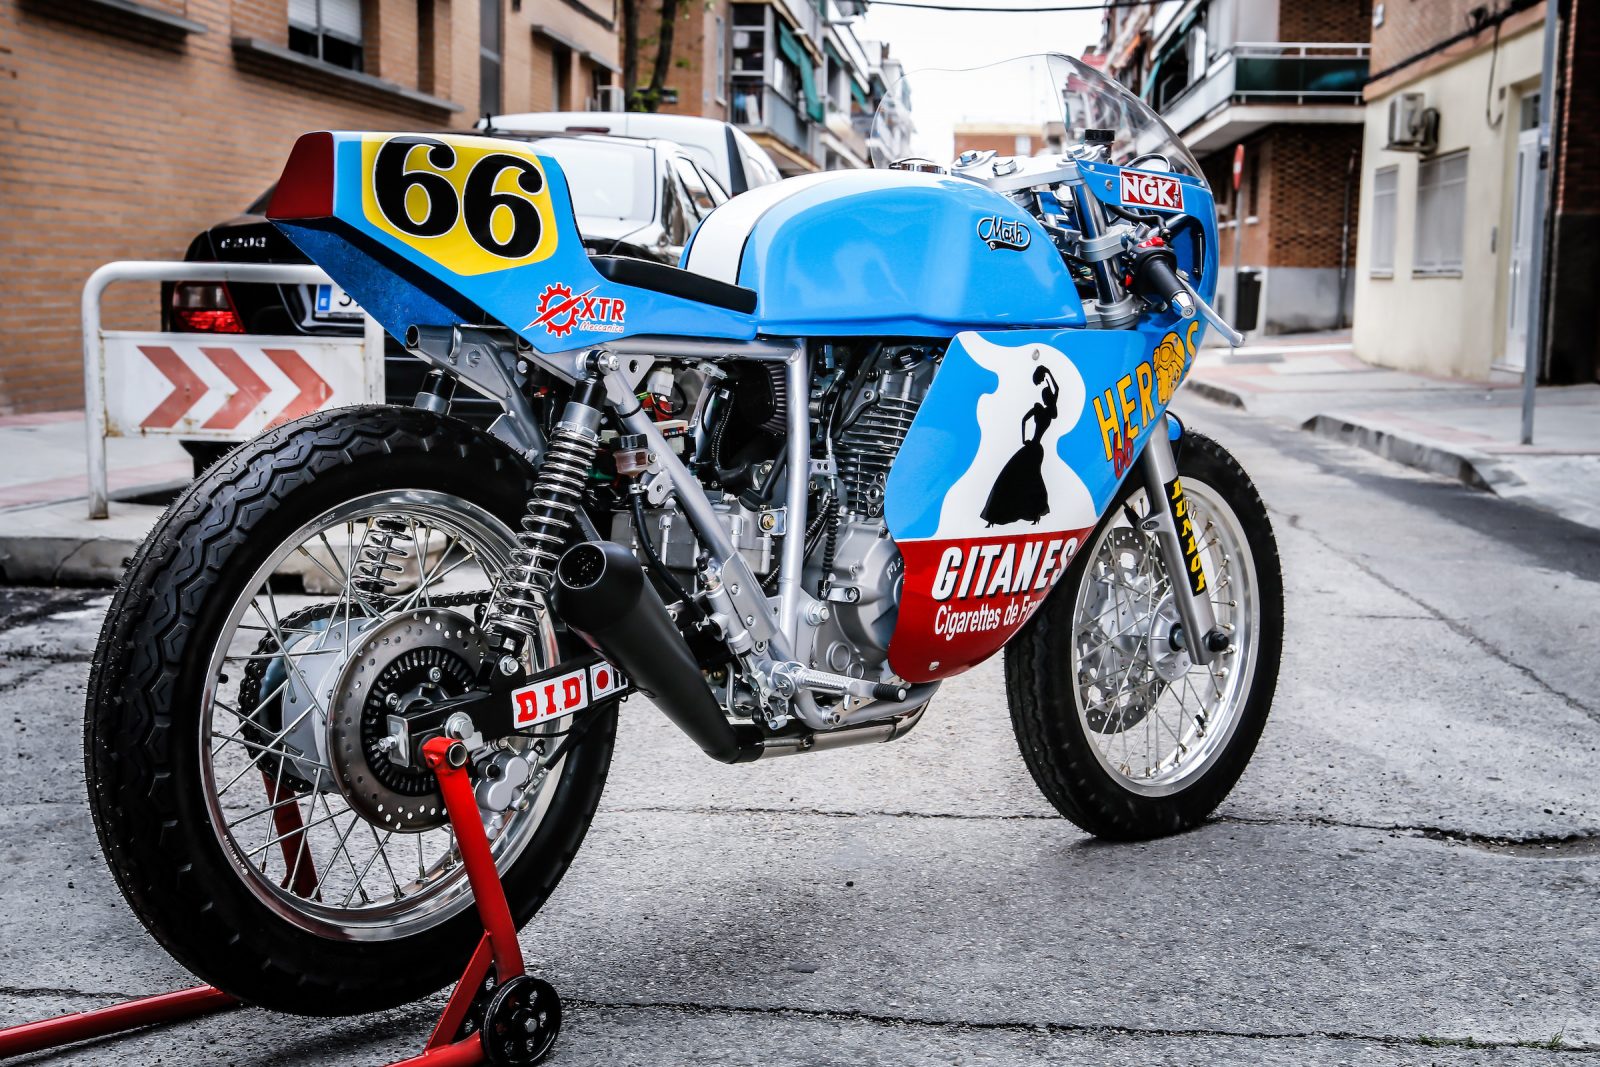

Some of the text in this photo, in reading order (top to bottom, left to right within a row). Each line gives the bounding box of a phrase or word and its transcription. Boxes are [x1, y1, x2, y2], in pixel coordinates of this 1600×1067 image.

[372, 135, 544, 260] 66
[1121, 174, 1174, 206] NGK
[977, 215, 1031, 252] Mash
[579, 297, 626, 323] XTR
[579, 320, 625, 333] Meccanica
[931, 537, 1078, 602] GITANES
[934, 602, 1002, 641] Cigarettes
[1003, 597, 1019, 626] de
